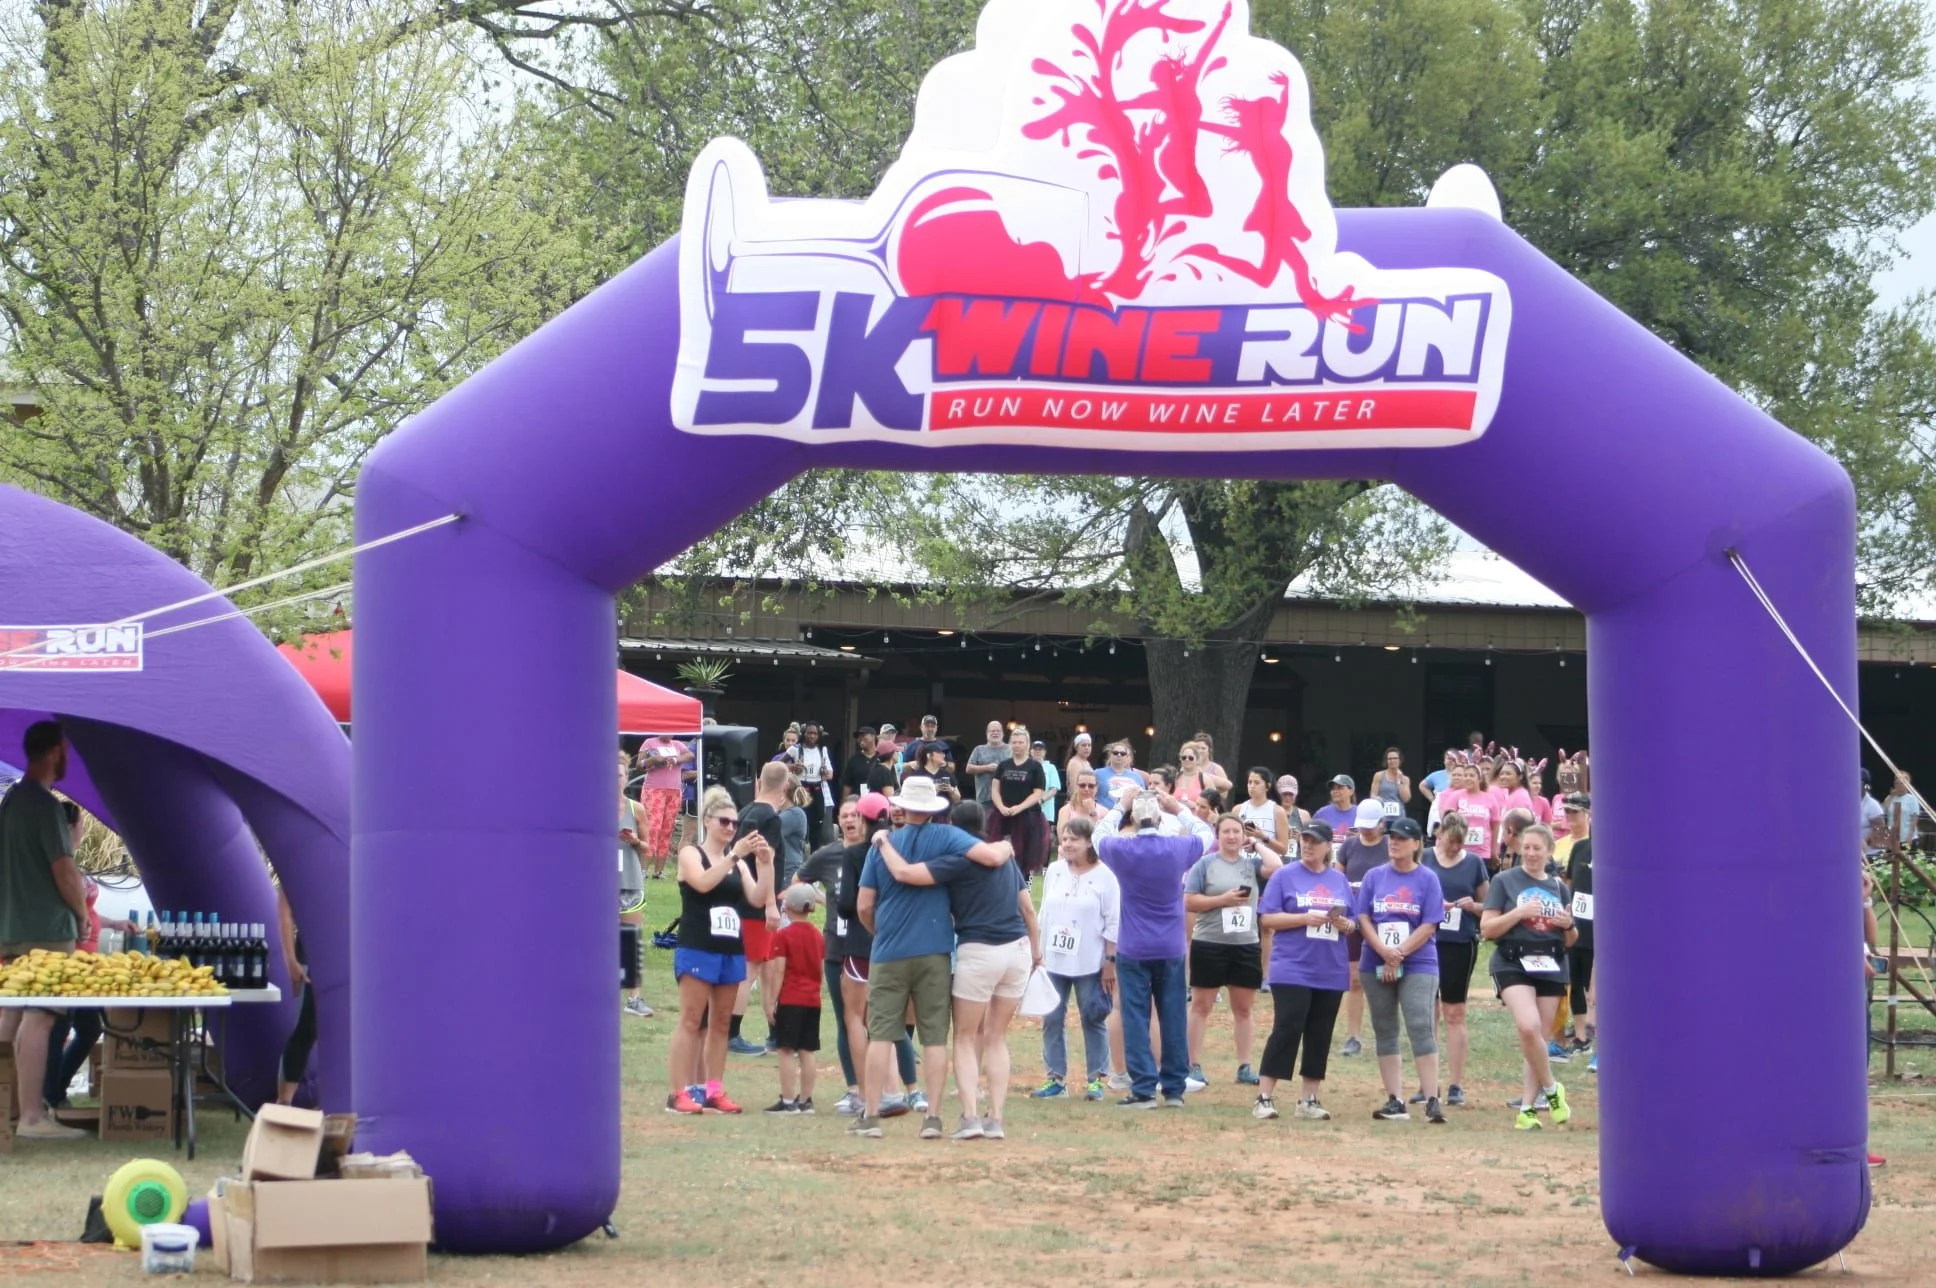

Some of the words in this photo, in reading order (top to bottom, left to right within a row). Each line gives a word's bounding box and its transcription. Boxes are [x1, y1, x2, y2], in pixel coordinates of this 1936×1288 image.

[692, 290, 936, 431] 5K
[919, 298, 1221, 382] WINE
[1236, 299, 1481, 382] RUN
[949, 397, 1021, 419] RUN
[1042, 398, 1128, 420] NOW
[1149, 402, 1241, 424] WINE
[1261, 399, 1376, 423] LATER
[46, 627, 137, 653] RUN
[1575, 901, 1587, 913] 20
[717, 915, 737, 931] 101
[1231, 914, 1245, 928] 42
[1052, 934, 1075, 950] 130
[1384, 932, 1400, 945] 78
